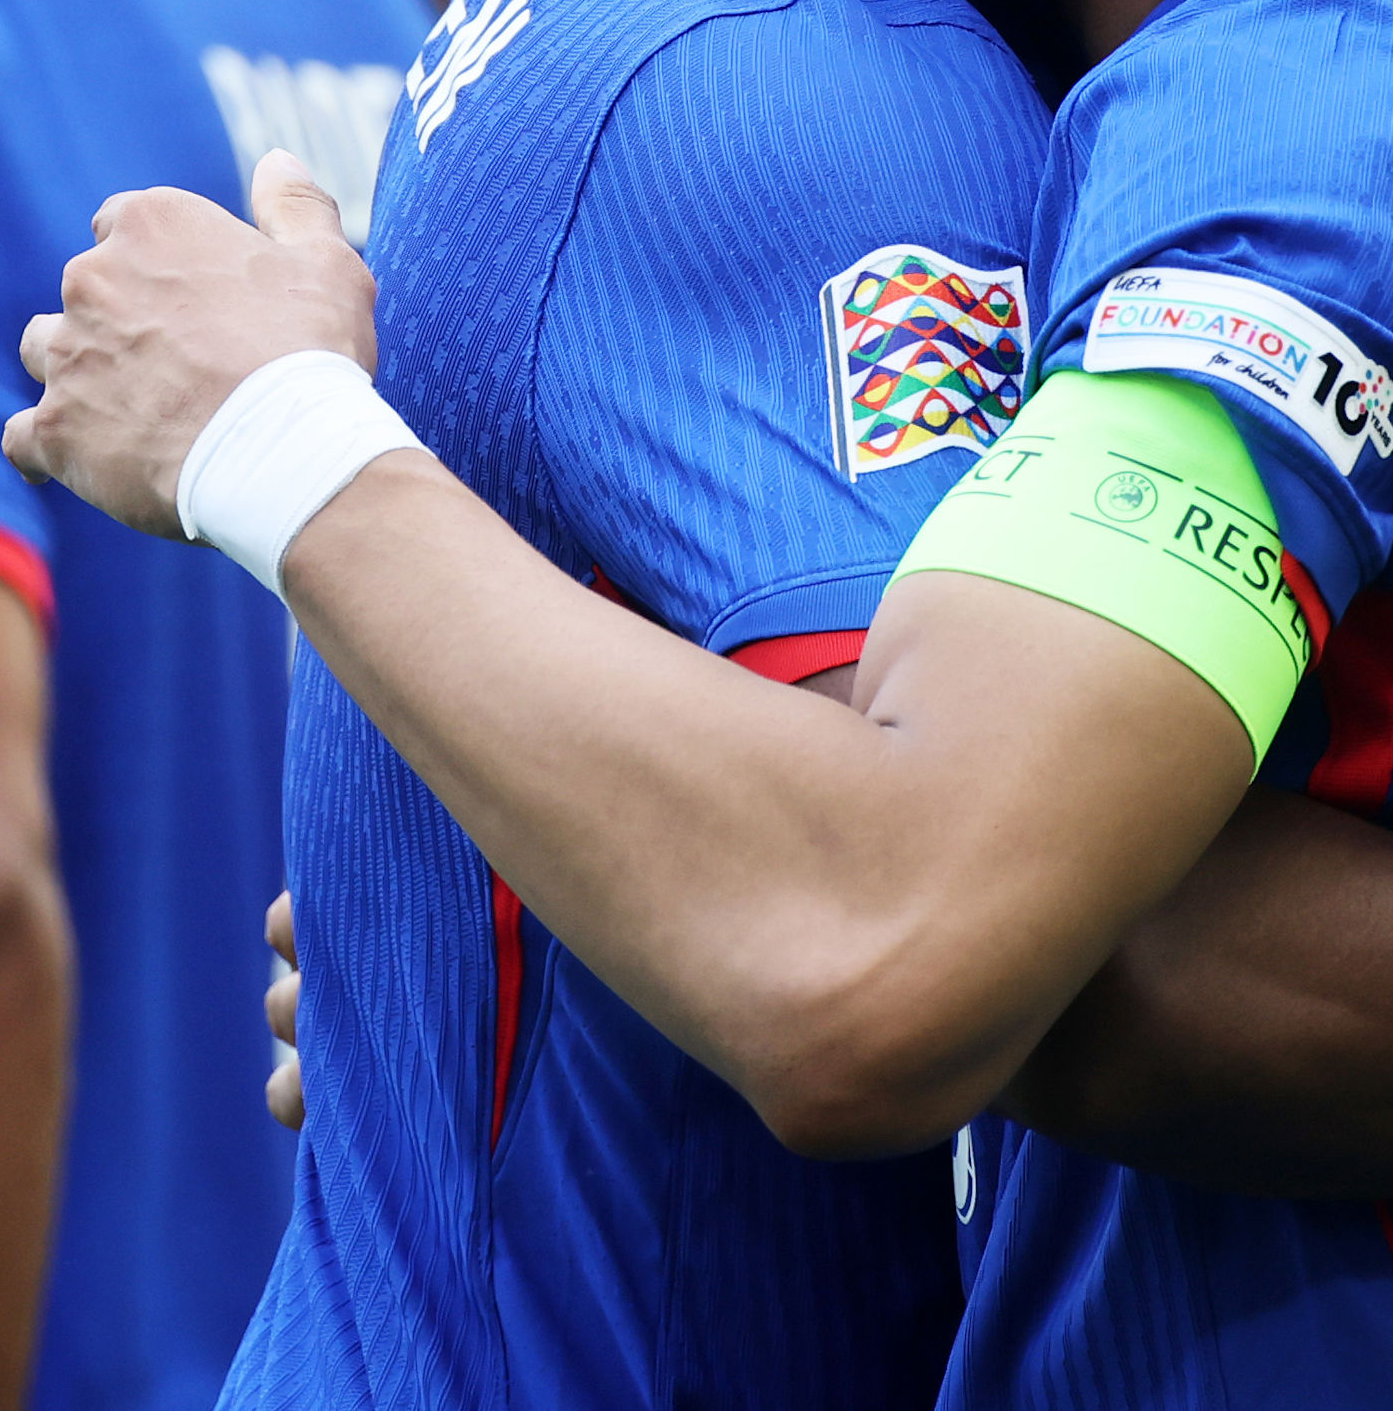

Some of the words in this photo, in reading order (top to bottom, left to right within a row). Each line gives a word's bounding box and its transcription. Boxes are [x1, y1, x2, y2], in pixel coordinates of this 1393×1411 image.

[1113, 276, 1162, 291] UEFA
[1099, 305, 1309, 374] FOUNDATION
[1206, 351, 1233, 367] for
[1235, 364, 1290, 401] children
[1313, 352, 1370, 437] 10
[1118, 475, 1151, 493] UEFA
